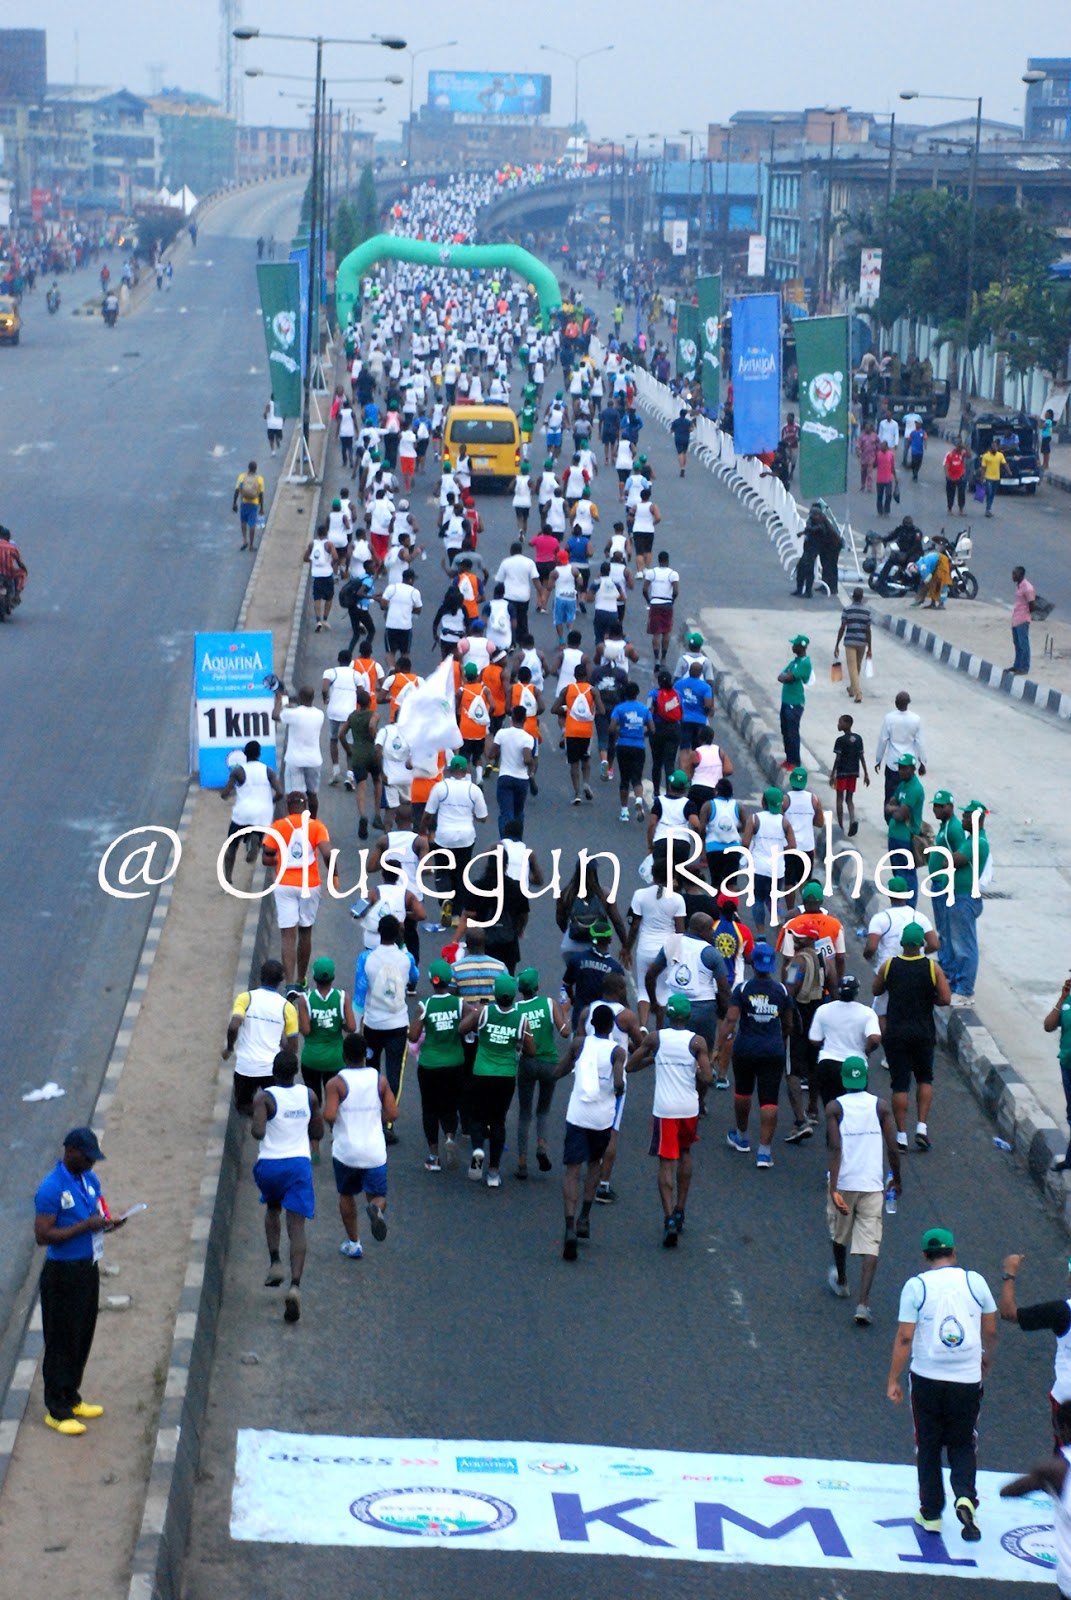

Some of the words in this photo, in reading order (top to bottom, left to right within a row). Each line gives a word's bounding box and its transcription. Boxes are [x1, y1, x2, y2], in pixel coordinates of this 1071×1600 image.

[201, 651, 263, 672] AQUAFINA
[203, 708, 216, 738] 1
[225, 707, 270, 738] km
[312, 1007, 338, 1020] TEAM
[429, 1010, 458, 1023] TEAM
[435, 1019, 454, 1032] SBC
[486, 1023, 517, 1038] TEAM
[489, 1033, 510, 1045] SBC
[267, 1453, 394, 1467] access
